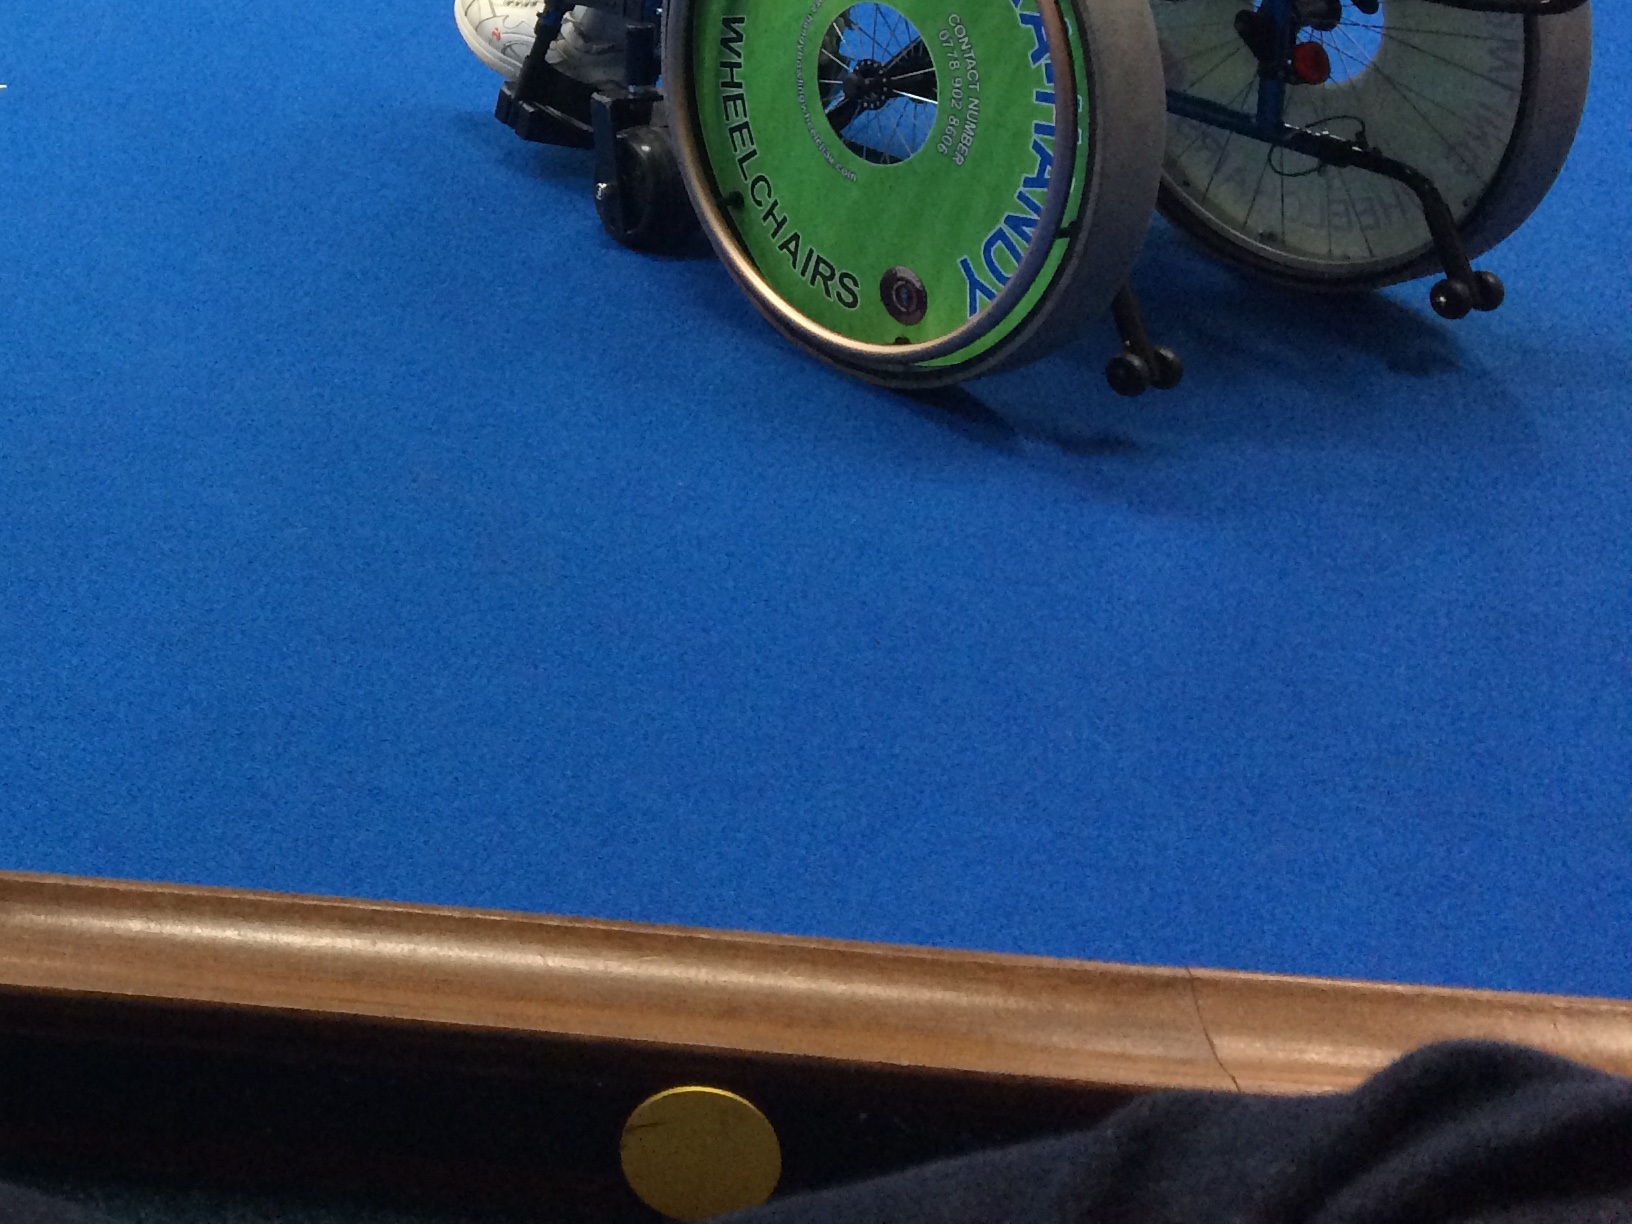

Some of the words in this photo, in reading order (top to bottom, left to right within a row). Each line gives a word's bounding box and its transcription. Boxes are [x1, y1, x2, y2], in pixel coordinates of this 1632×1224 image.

[938, 29, 961, 71] 0778
[948, 13, 981, 92] CONTACT
[950, 77, 965, 111] 902
[936, 115, 961, 156] 8606
[951, 97, 981, 167] NUMBER
[718, 14, 862, 311] WHEELCHAIRS
